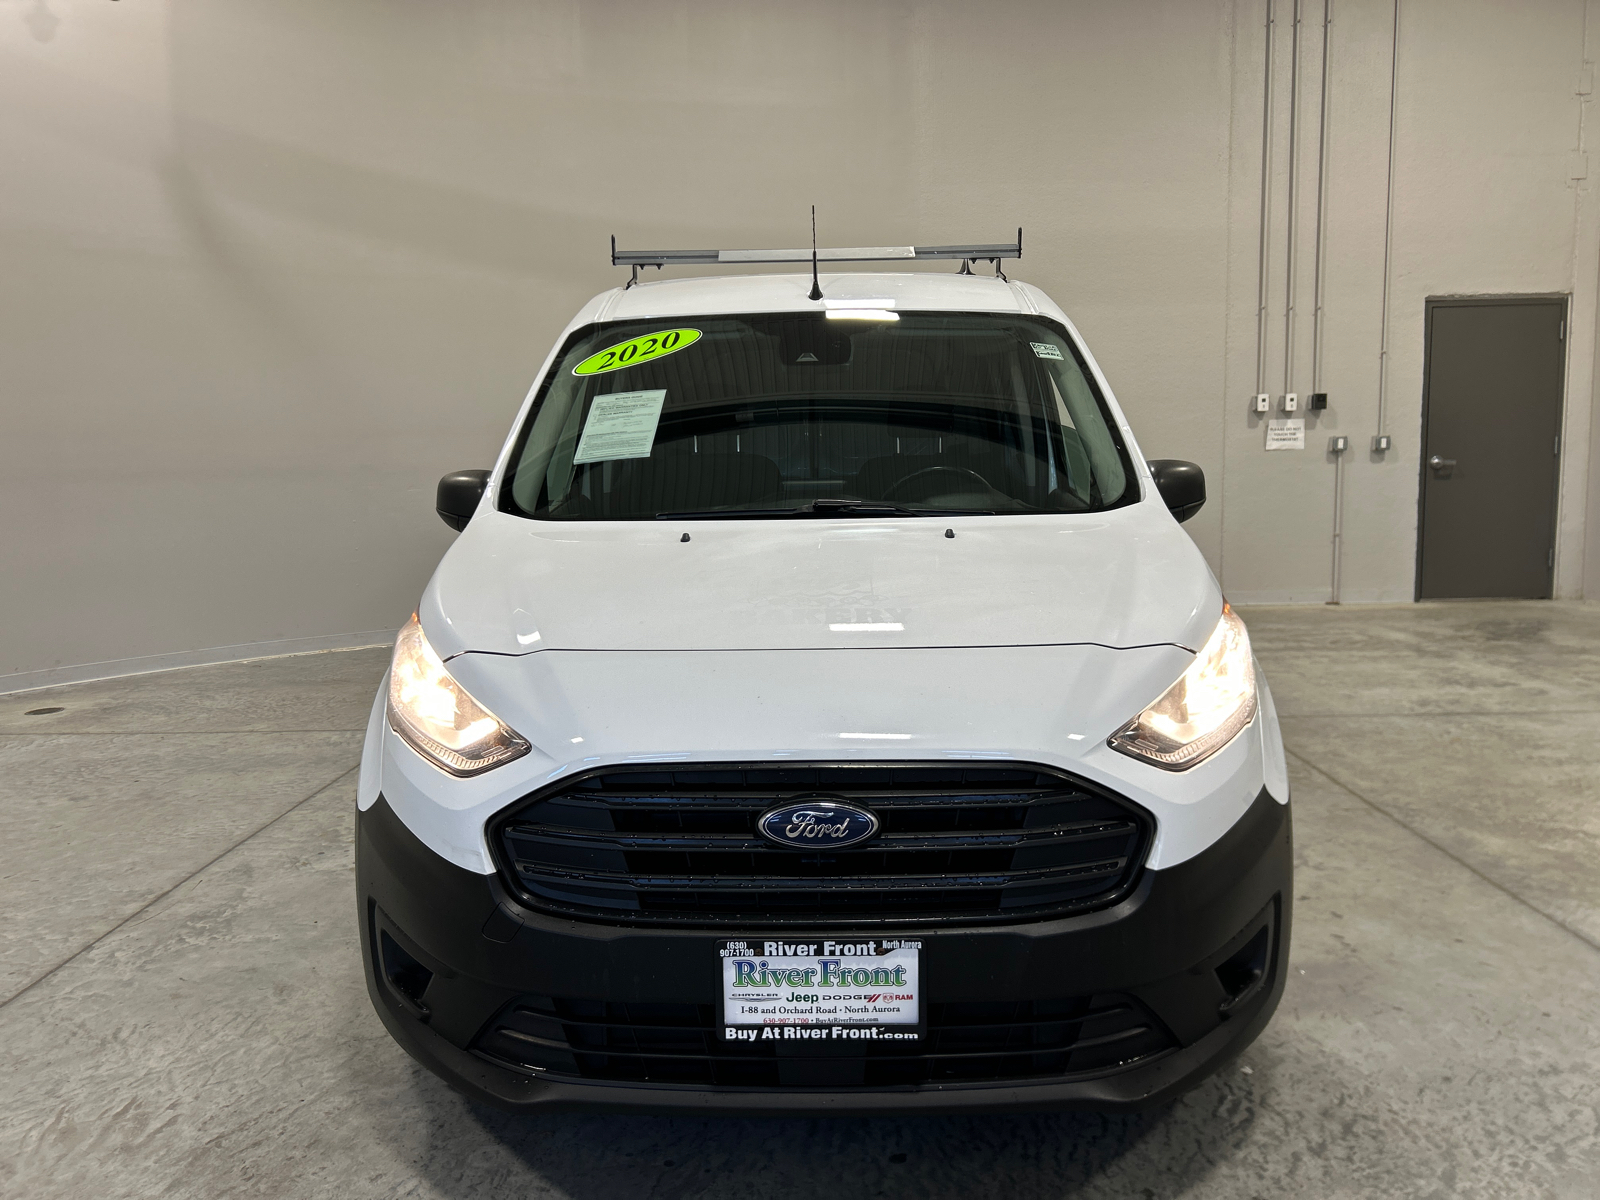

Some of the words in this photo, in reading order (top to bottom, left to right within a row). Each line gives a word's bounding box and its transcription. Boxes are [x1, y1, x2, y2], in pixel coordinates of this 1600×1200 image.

[597, 332, 680, 370] 2020
[785, 811, 850, 838] Ford
[720, 949, 754, 957] 907-1700
[764, 942, 817, 956] River
[823, 941, 876, 956] Front
[882, 940, 899, 949] North
[901, 941, 922, 949] Aurora
[732, 960, 817, 987] River
[818, 959, 907, 987] Front
[786, 992, 819, 1004] Jeep
[741, 1006, 759, 1014] I-88
[761, 1006, 776, 1014] and
[778, 1006, 813, 1014] Orchard
[816, 1006, 837, 1014] Road
[844, 1005, 869, 1013] North
[871, 1005, 900, 1013] Aurora
[725, 1027, 757, 1042] Buy
[762, 1027, 780, 1039] At
[783, 1026, 828, 1039] River
